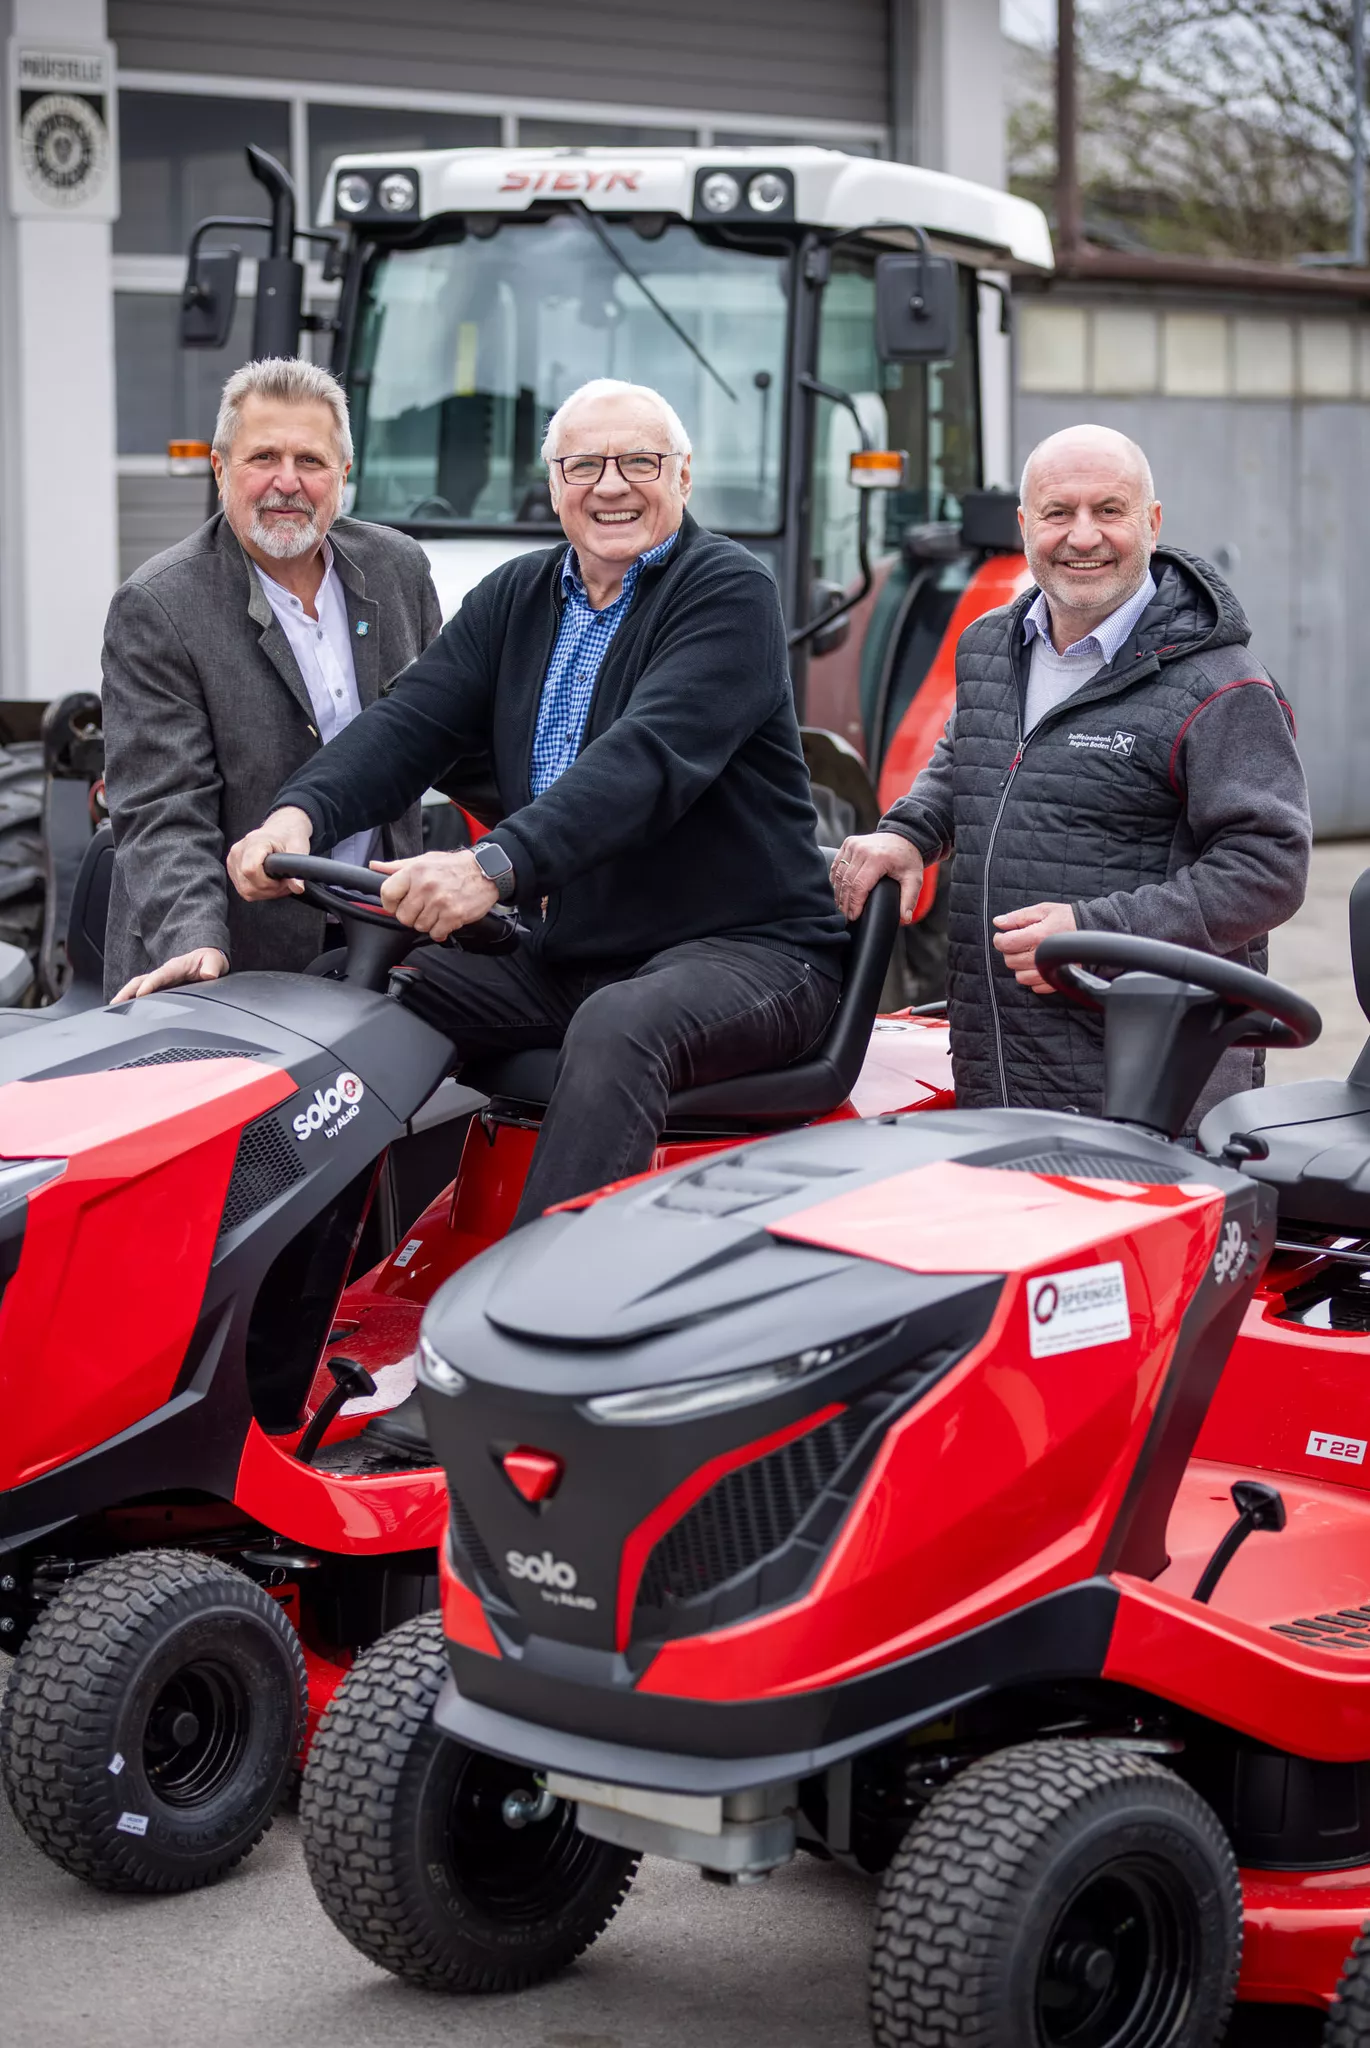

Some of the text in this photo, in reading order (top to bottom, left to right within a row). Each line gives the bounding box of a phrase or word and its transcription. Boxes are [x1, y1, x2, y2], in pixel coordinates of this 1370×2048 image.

[20, 56, 102, 83] PRÜFSTELLE
[499, 169, 643, 192] STEYR
[1068, 733, 1112, 743] Raiffeisenbank
[1069, 739, 1089, 748] Region
[293, 1087, 342, 1140] solo
[324, 1124, 339, 1138] by
[1214, 1221, 1241, 1285] solo
[1061, 1283, 1121, 1307] SPERINGER
[1314, 1437, 1360, 1458] T 22
[506, 1549, 577, 1590] solo
